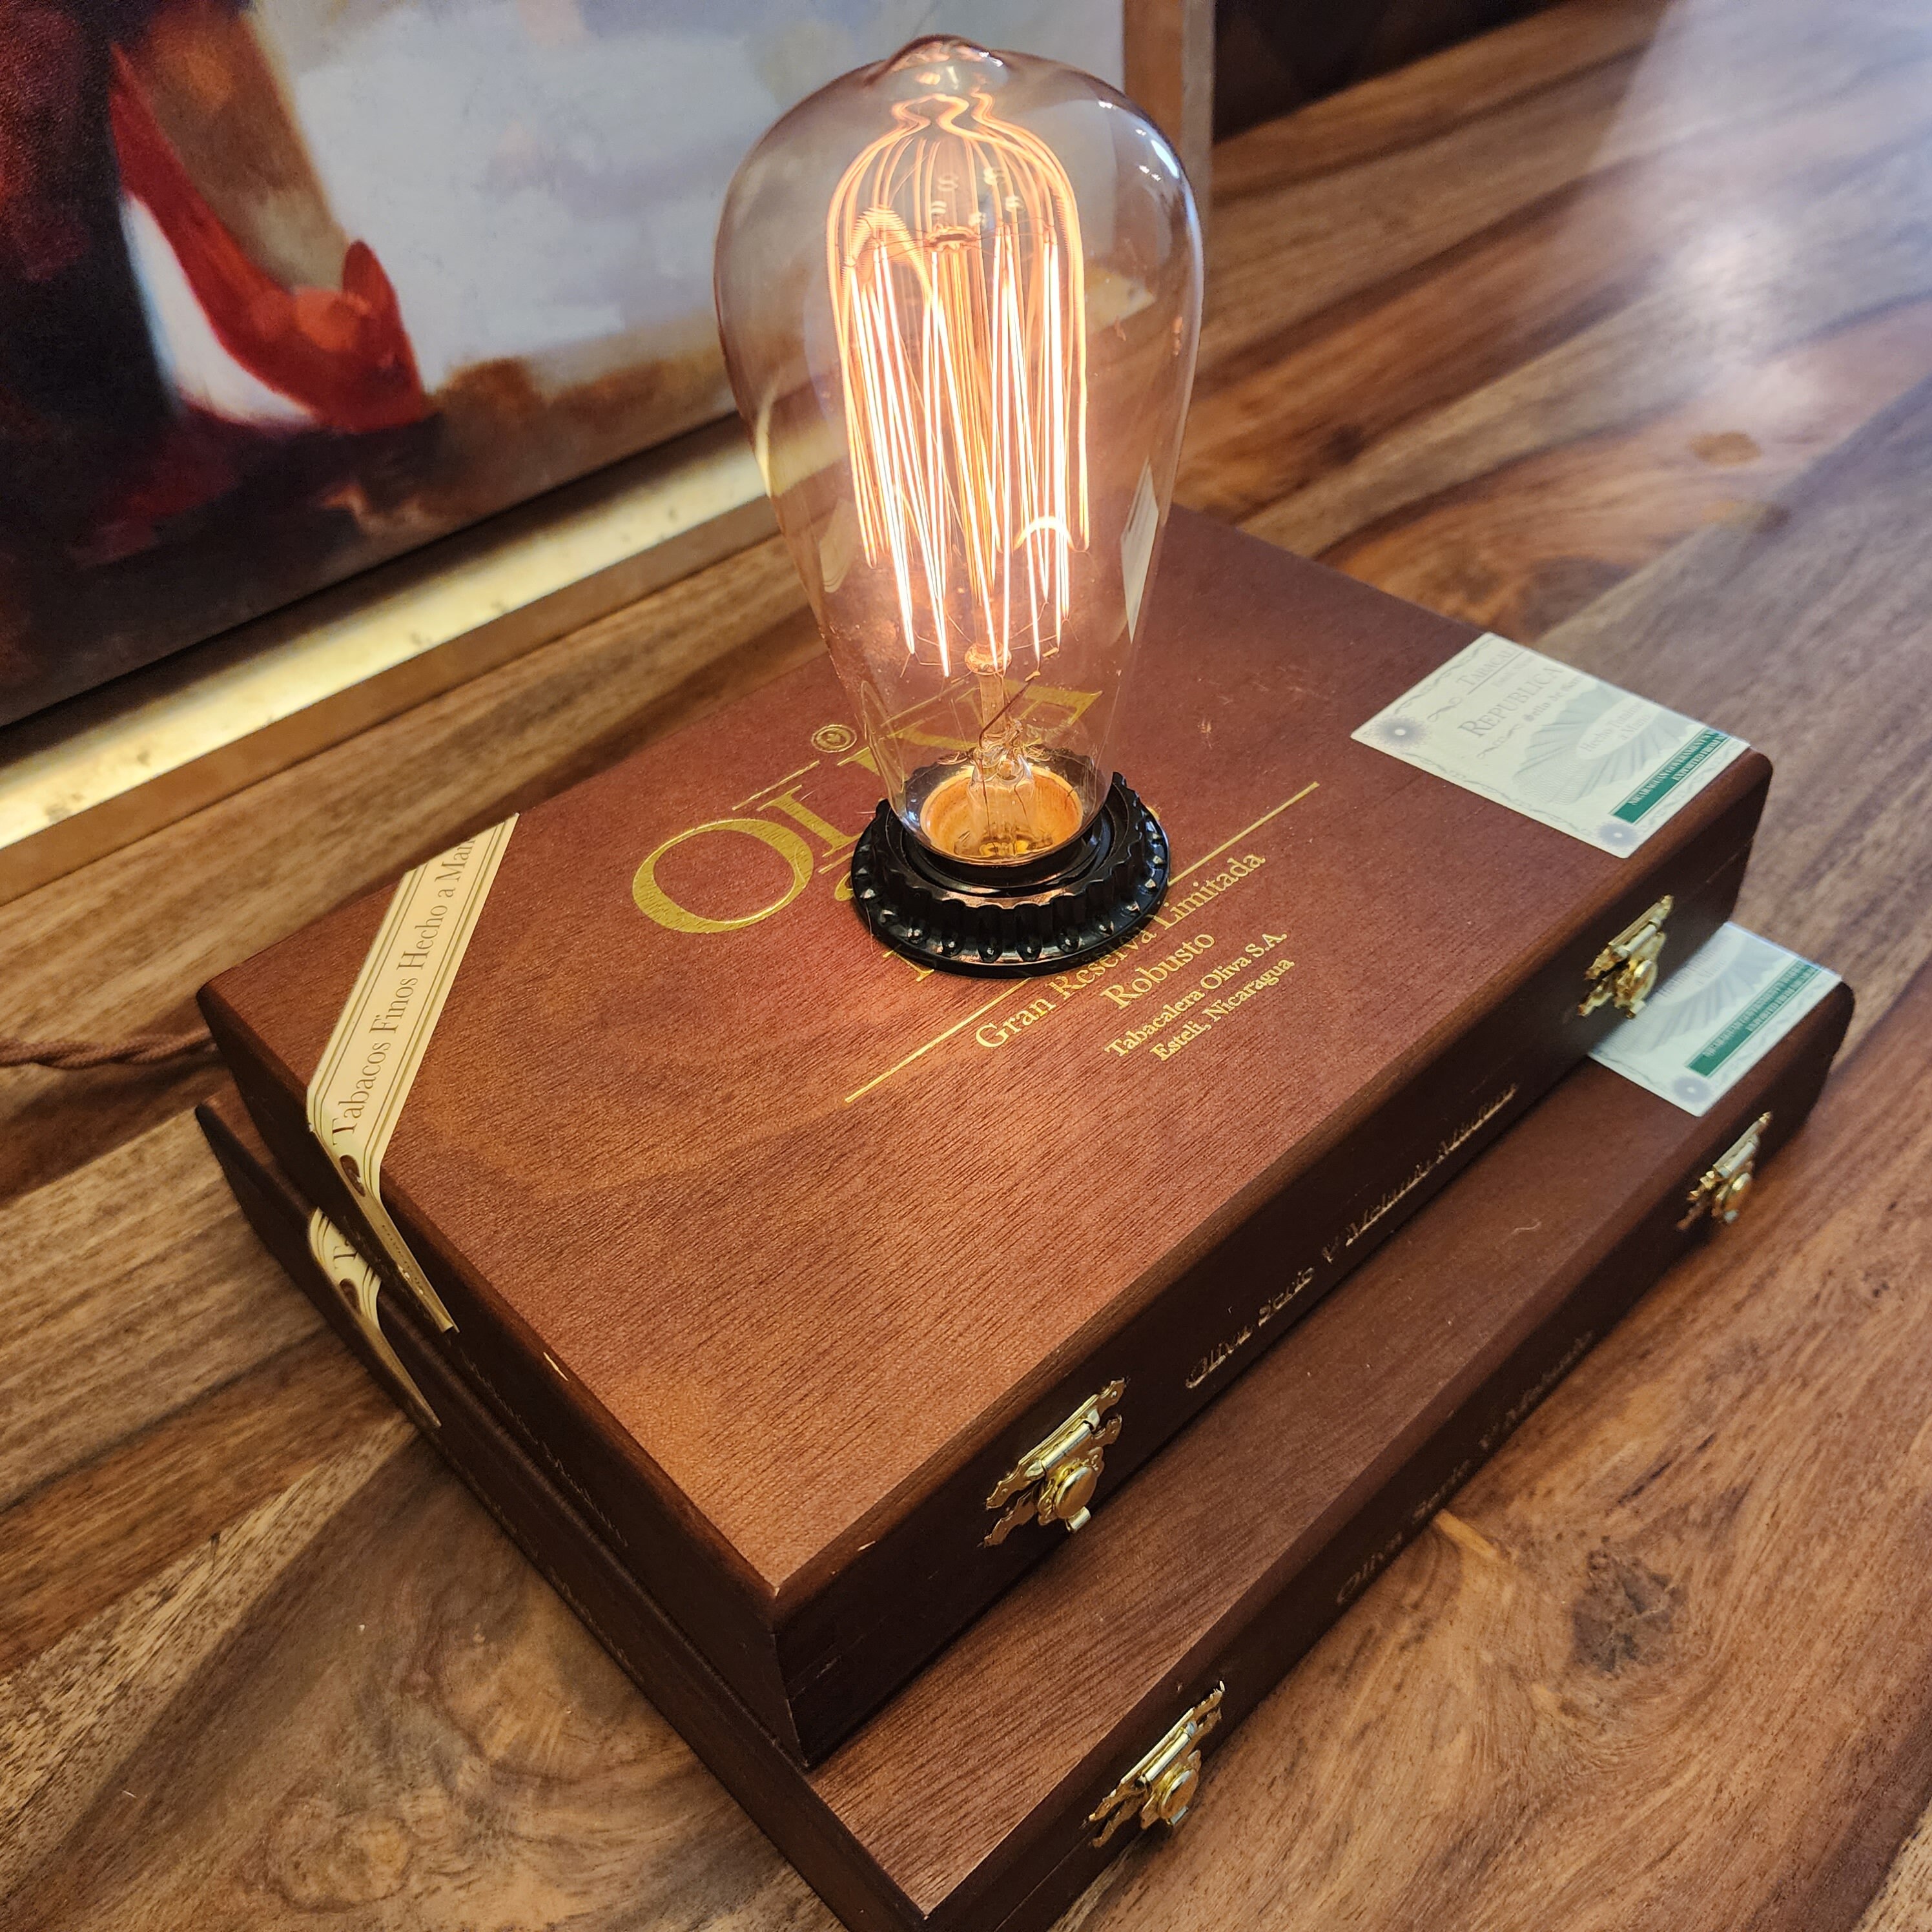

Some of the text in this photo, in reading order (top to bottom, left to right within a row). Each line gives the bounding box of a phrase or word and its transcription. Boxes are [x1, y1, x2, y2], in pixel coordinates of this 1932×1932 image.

[1457, 666, 1564, 737] REPUBLICA
[975, 851, 1266, 1049] Gran Reserva Limitada
[1099, 934, 1215, 1011] Robusto
[1104, 933, 1288, 1057] Tabacalera Oliva S.A.
[1202, 959, 1295, 1023] Nicaragua
[333, 1042, 391, 1146] Tabacos
[369, 977, 418, 1034] Finos
[396, 905, 448, 971] Hecho
[437, 888, 456, 898] a
